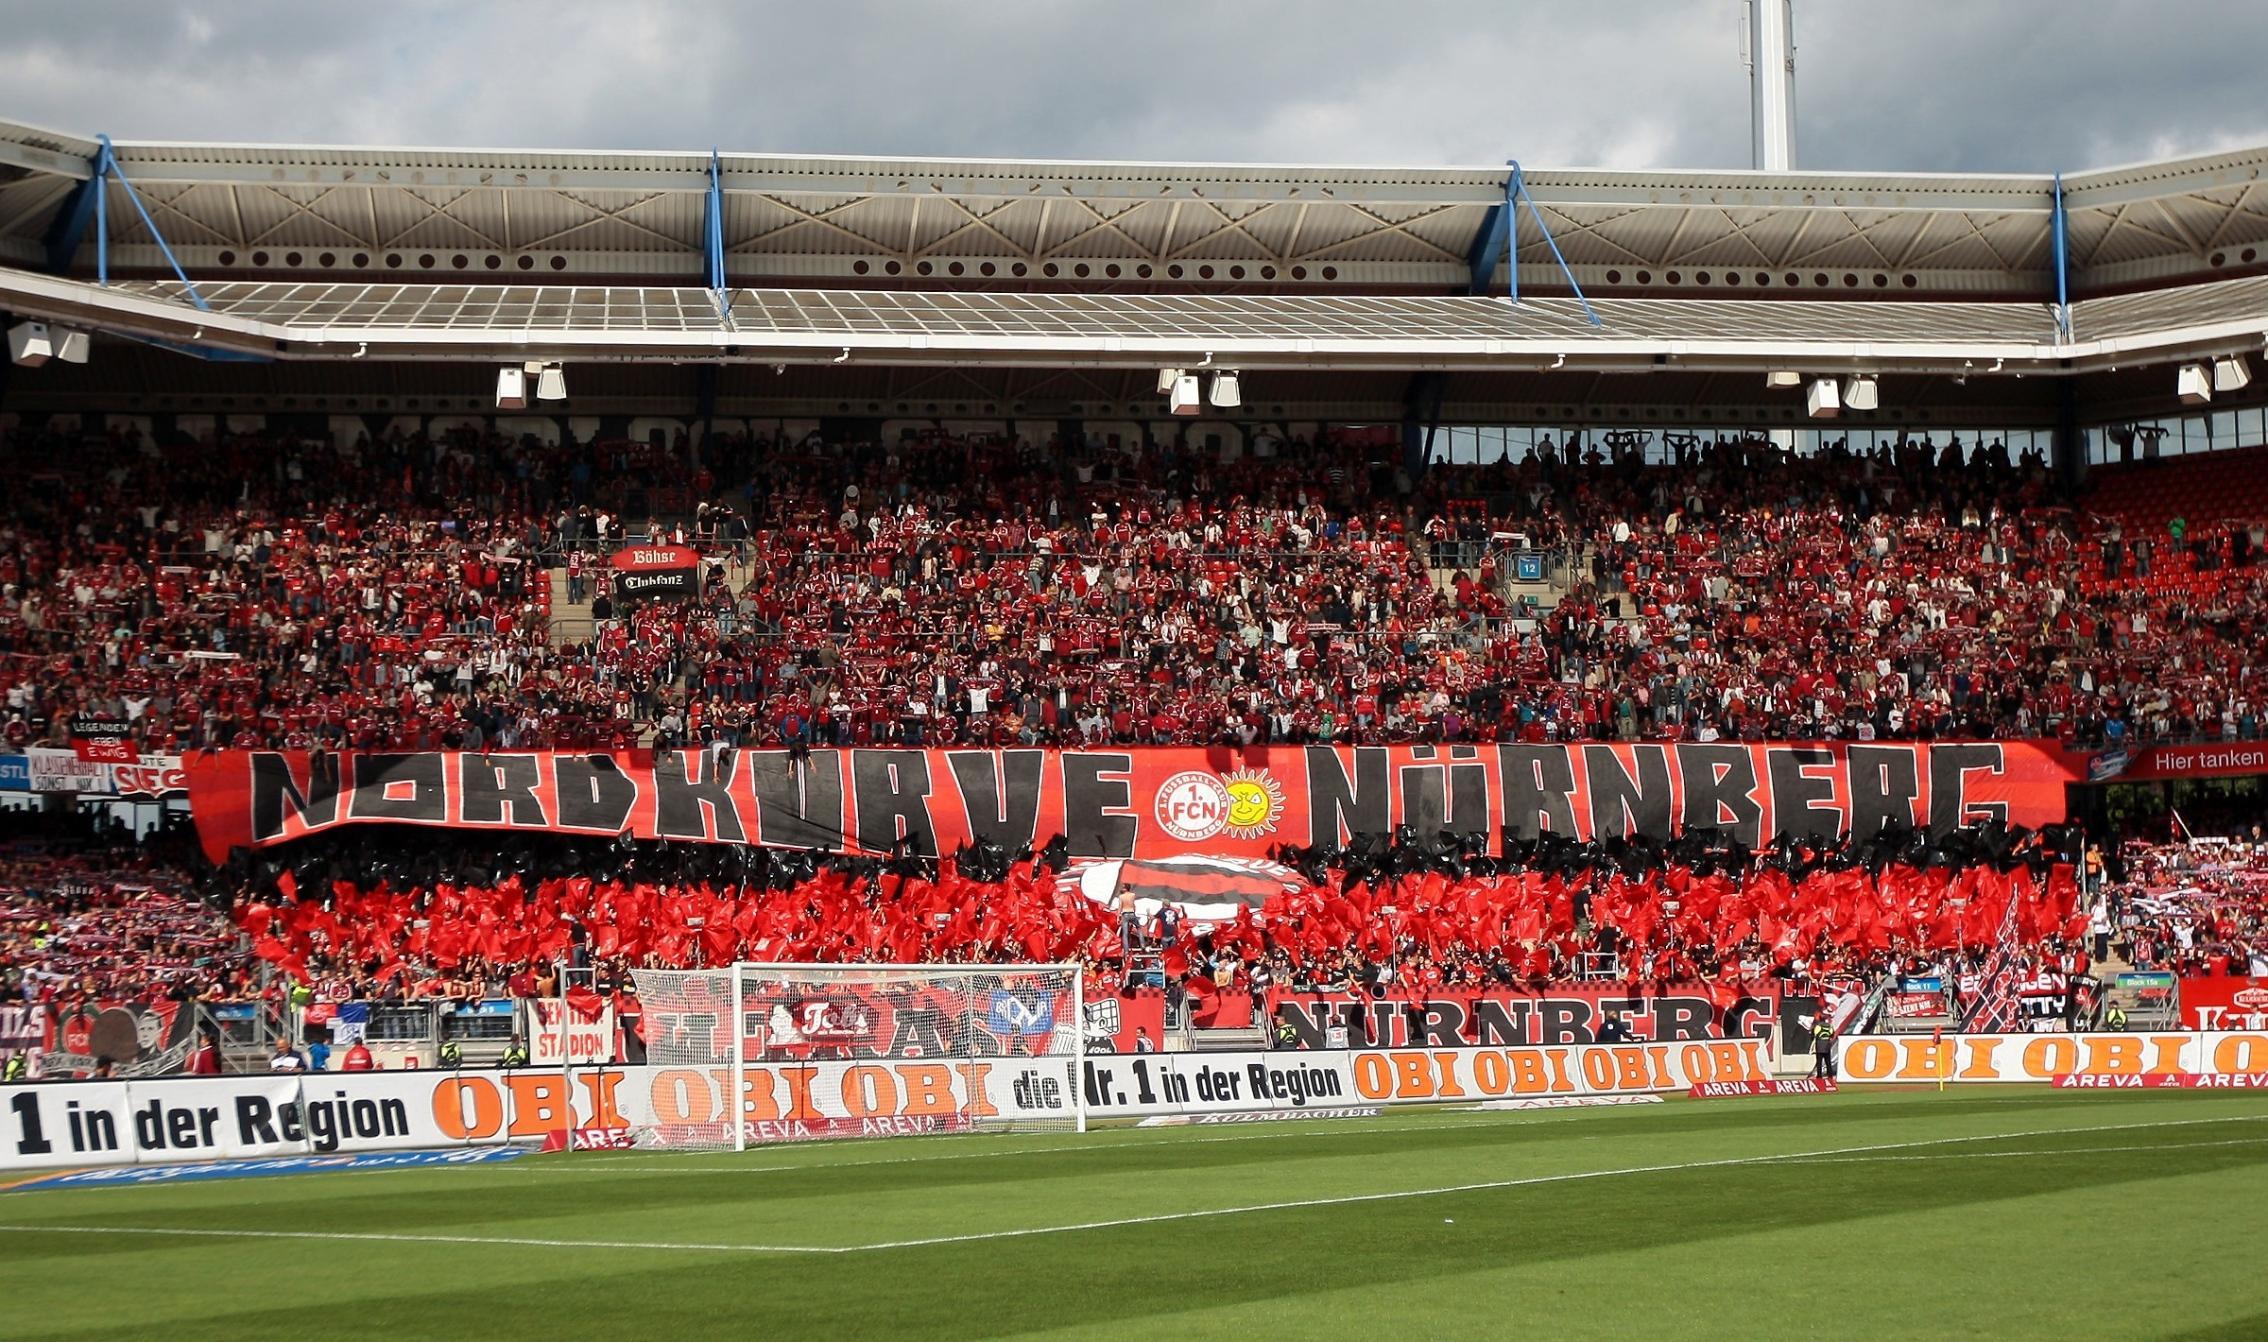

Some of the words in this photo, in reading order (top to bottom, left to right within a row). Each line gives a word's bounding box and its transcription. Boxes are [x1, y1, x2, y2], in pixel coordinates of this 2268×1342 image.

[632, 550, 676, 565] Böhse
[1525, 563, 1536, 573] 12
[73, 722, 129, 732] LEGENDEN
[88, 747, 129, 759] EWIG
[2156, 753, 2194, 770] Hier
[2199, 749, 2264, 769] tanken
[115, 765, 187, 793] SIEG
[249, 746, 1137, 861] NORDKURVE
[1304, 741, 2010, 853] NÜRNBERG
[1188, 784, 1203, 801] 1.
[1173, 802, 1215, 820] FCN
[539, 1033, 604, 1058] STADION
[1844, 1038, 2003, 1079] OBI
[2022, 1036, 2192, 1078] OBI
[1353, 1051, 1465, 1100] OBI
[1473, 1048, 1575, 1095] OBI
[1583, 1045, 1676, 1091] OBI
[1680, 1042, 1766, 1084] OBI
[1013, 1070, 1061, 1111] die
[1133, 1058, 1157, 1104] 1
[1160, 1066, 1188, 1103] in
[1196, 1064, 1241, 1102] der
[1248, 1061, 1342, 1106] Region
[1776, 1079, 1820, 1094] AREVA
[2062, 1074, 2144, 1088] AREVA
[2195, 1073, 2268, 1088] AREV
[1703, 1082, 1751, 1097] AREVA
[432, 1072, 630, 1139] OBI
[650, 1067, 825, 1128] OBI
[840, 1063, 999, 1118] OBI
[11, 1091, 51, 1155] 1
[67, 1100, 118, 1153] in
[135, 1098, 219, 1151] der
[235, 1090, 410, 1152] Region
[1200, 1107, 1378, 1123] KULMBACHER
